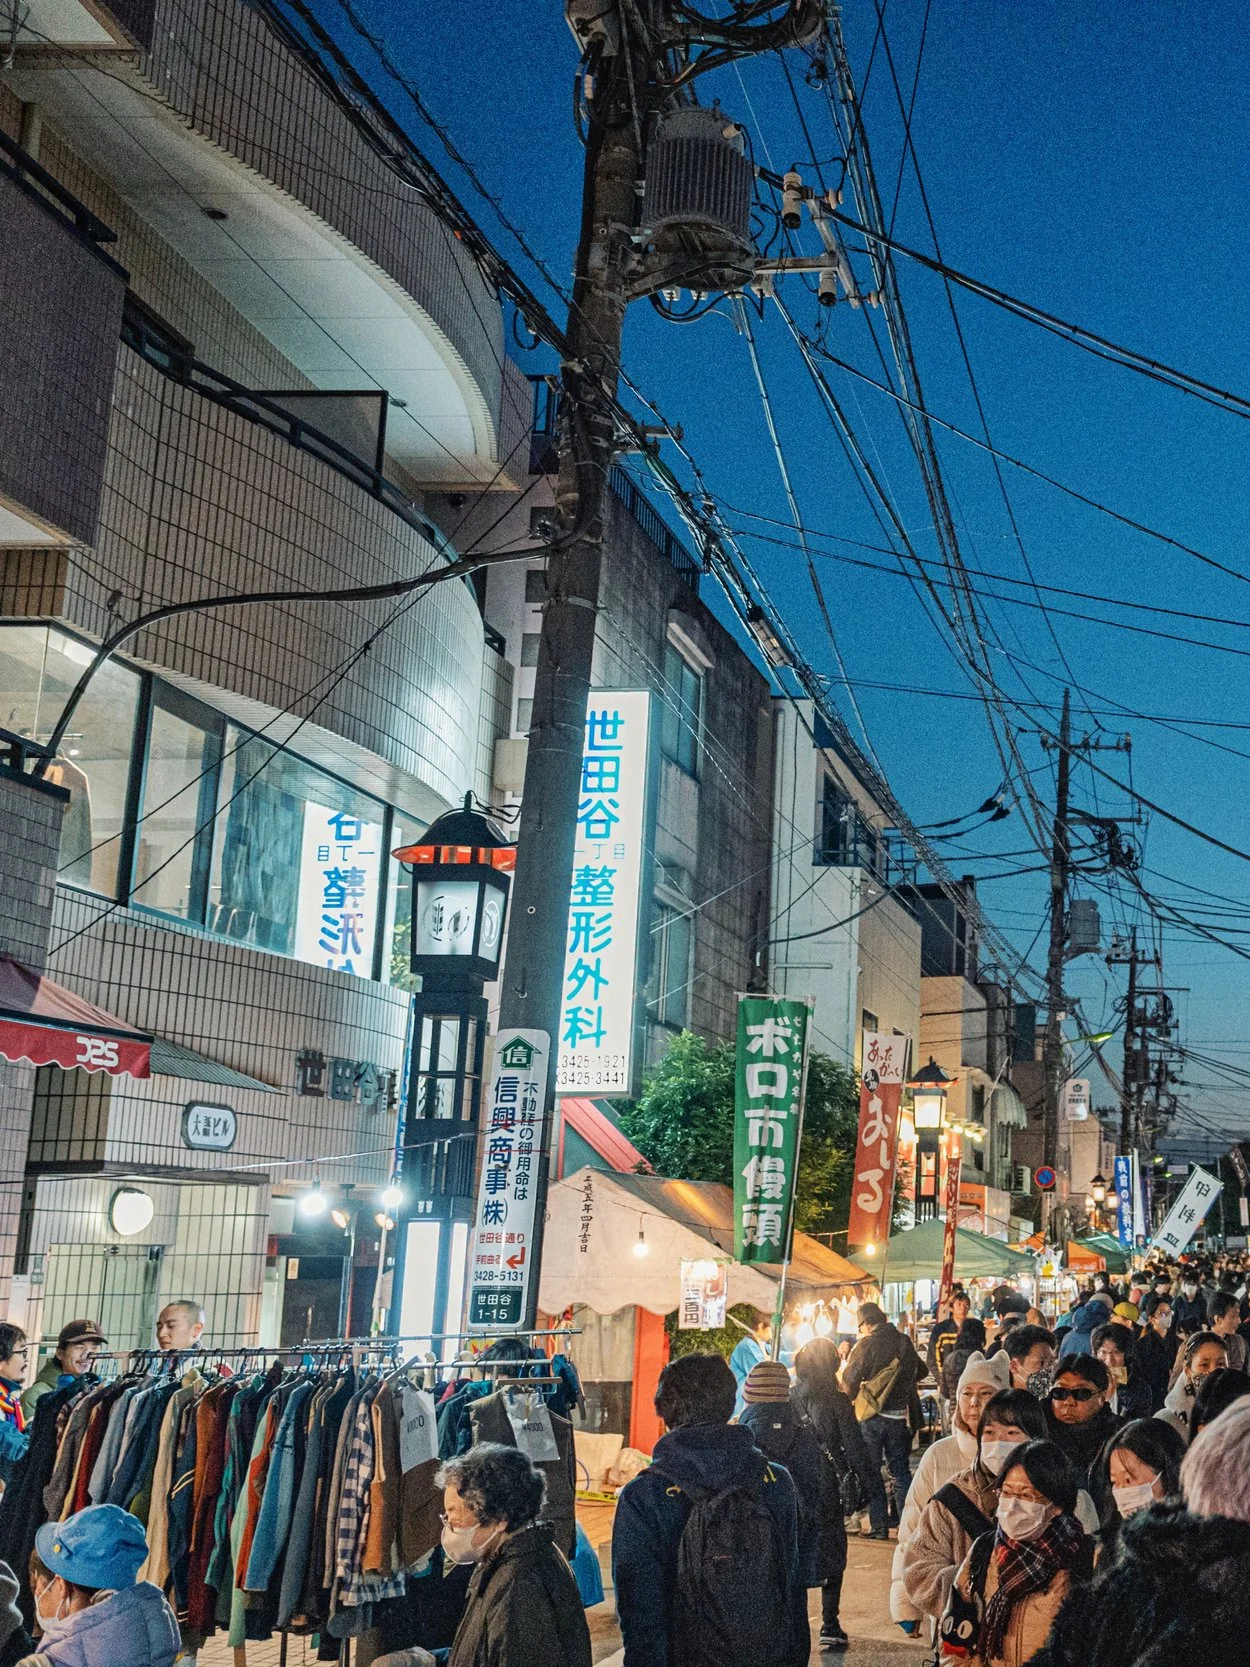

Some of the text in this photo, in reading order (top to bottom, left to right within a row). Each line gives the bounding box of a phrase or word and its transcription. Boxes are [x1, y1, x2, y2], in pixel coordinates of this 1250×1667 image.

[576, 710, 625, 839] 世田谷
[575, 843, 625, 860] 一丁目
[563, 865, 617, 1049] 整形外科
[505, 1046, 528, 1064] 信
[479, 1233, 525, 1244] 世田谷通り
[474, 1271, 524, 1282] 3428-5131
[477, 1294, 512, 1305] 世田谷
[478, 1309, 508, 1320] 1-15
